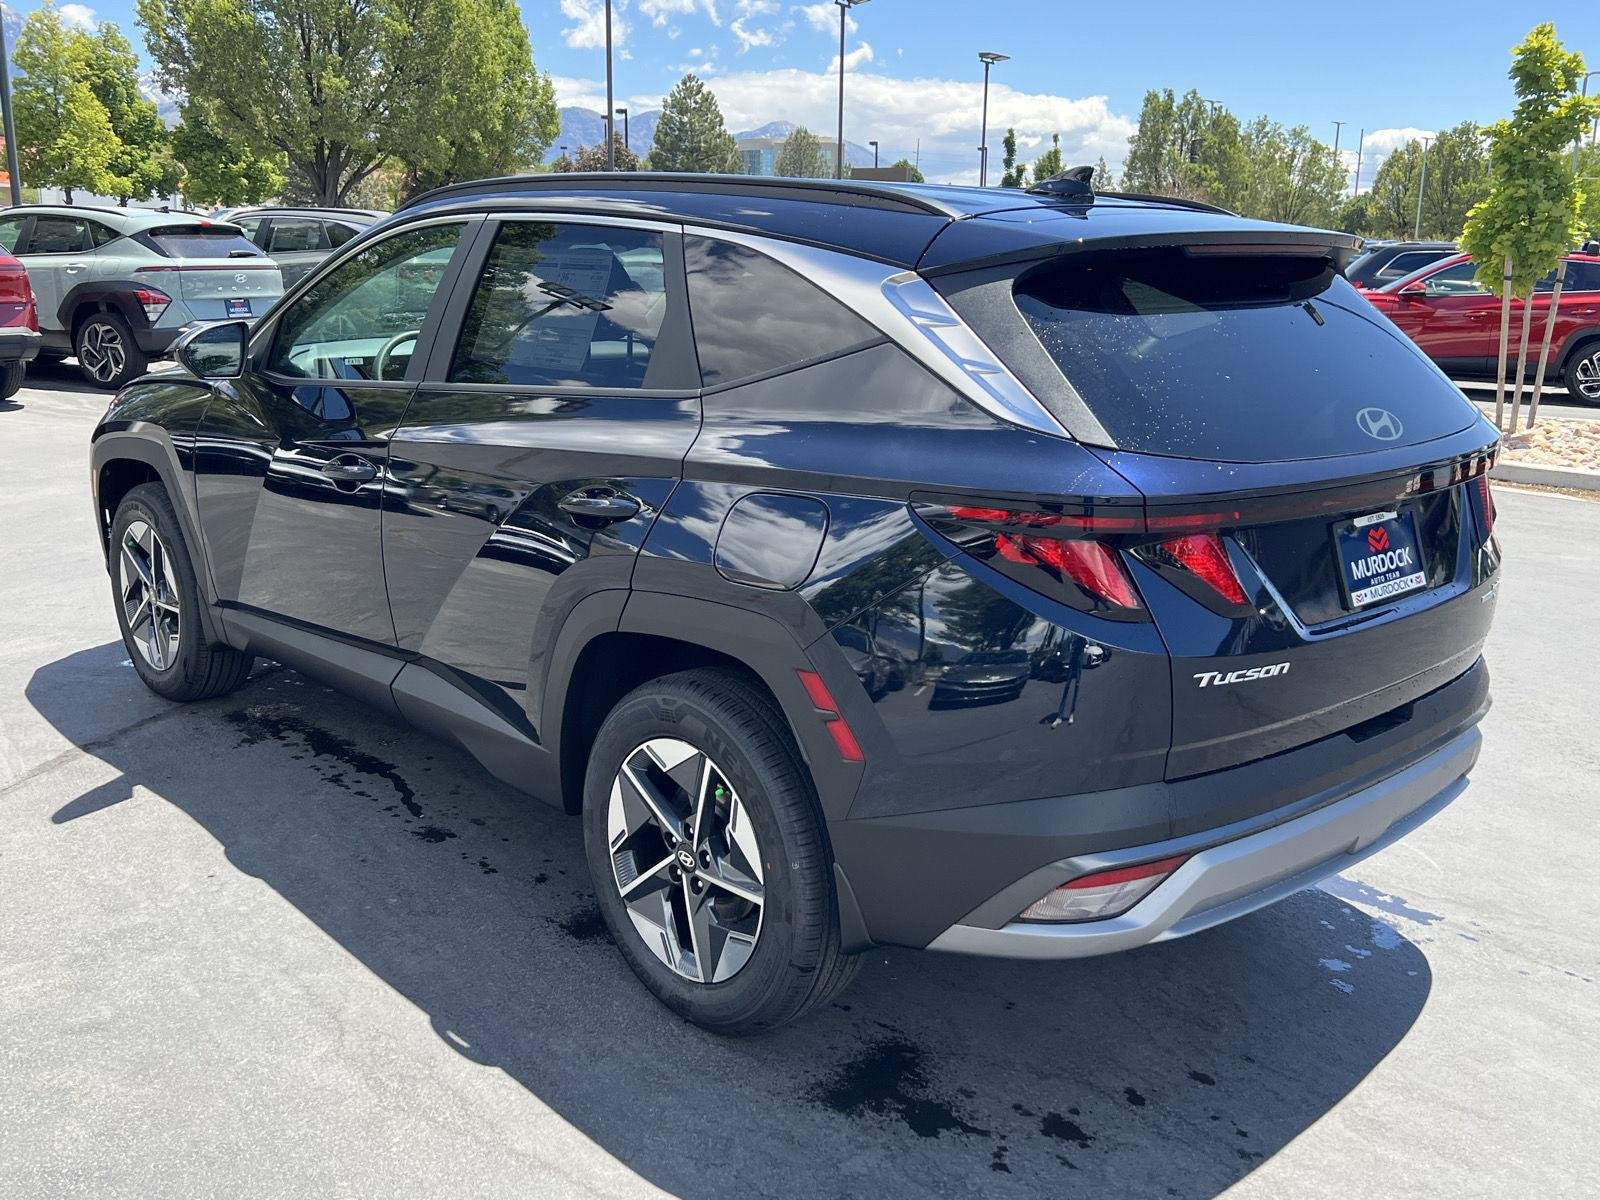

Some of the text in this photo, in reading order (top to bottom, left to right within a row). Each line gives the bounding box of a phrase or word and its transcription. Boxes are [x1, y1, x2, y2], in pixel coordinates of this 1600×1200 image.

[1351, 546, 1412, 580] MURDOCK
[1369, 578, 1410, 599] MURDOCK
[1370, 571, 1400, 586] AUTO TEAM
